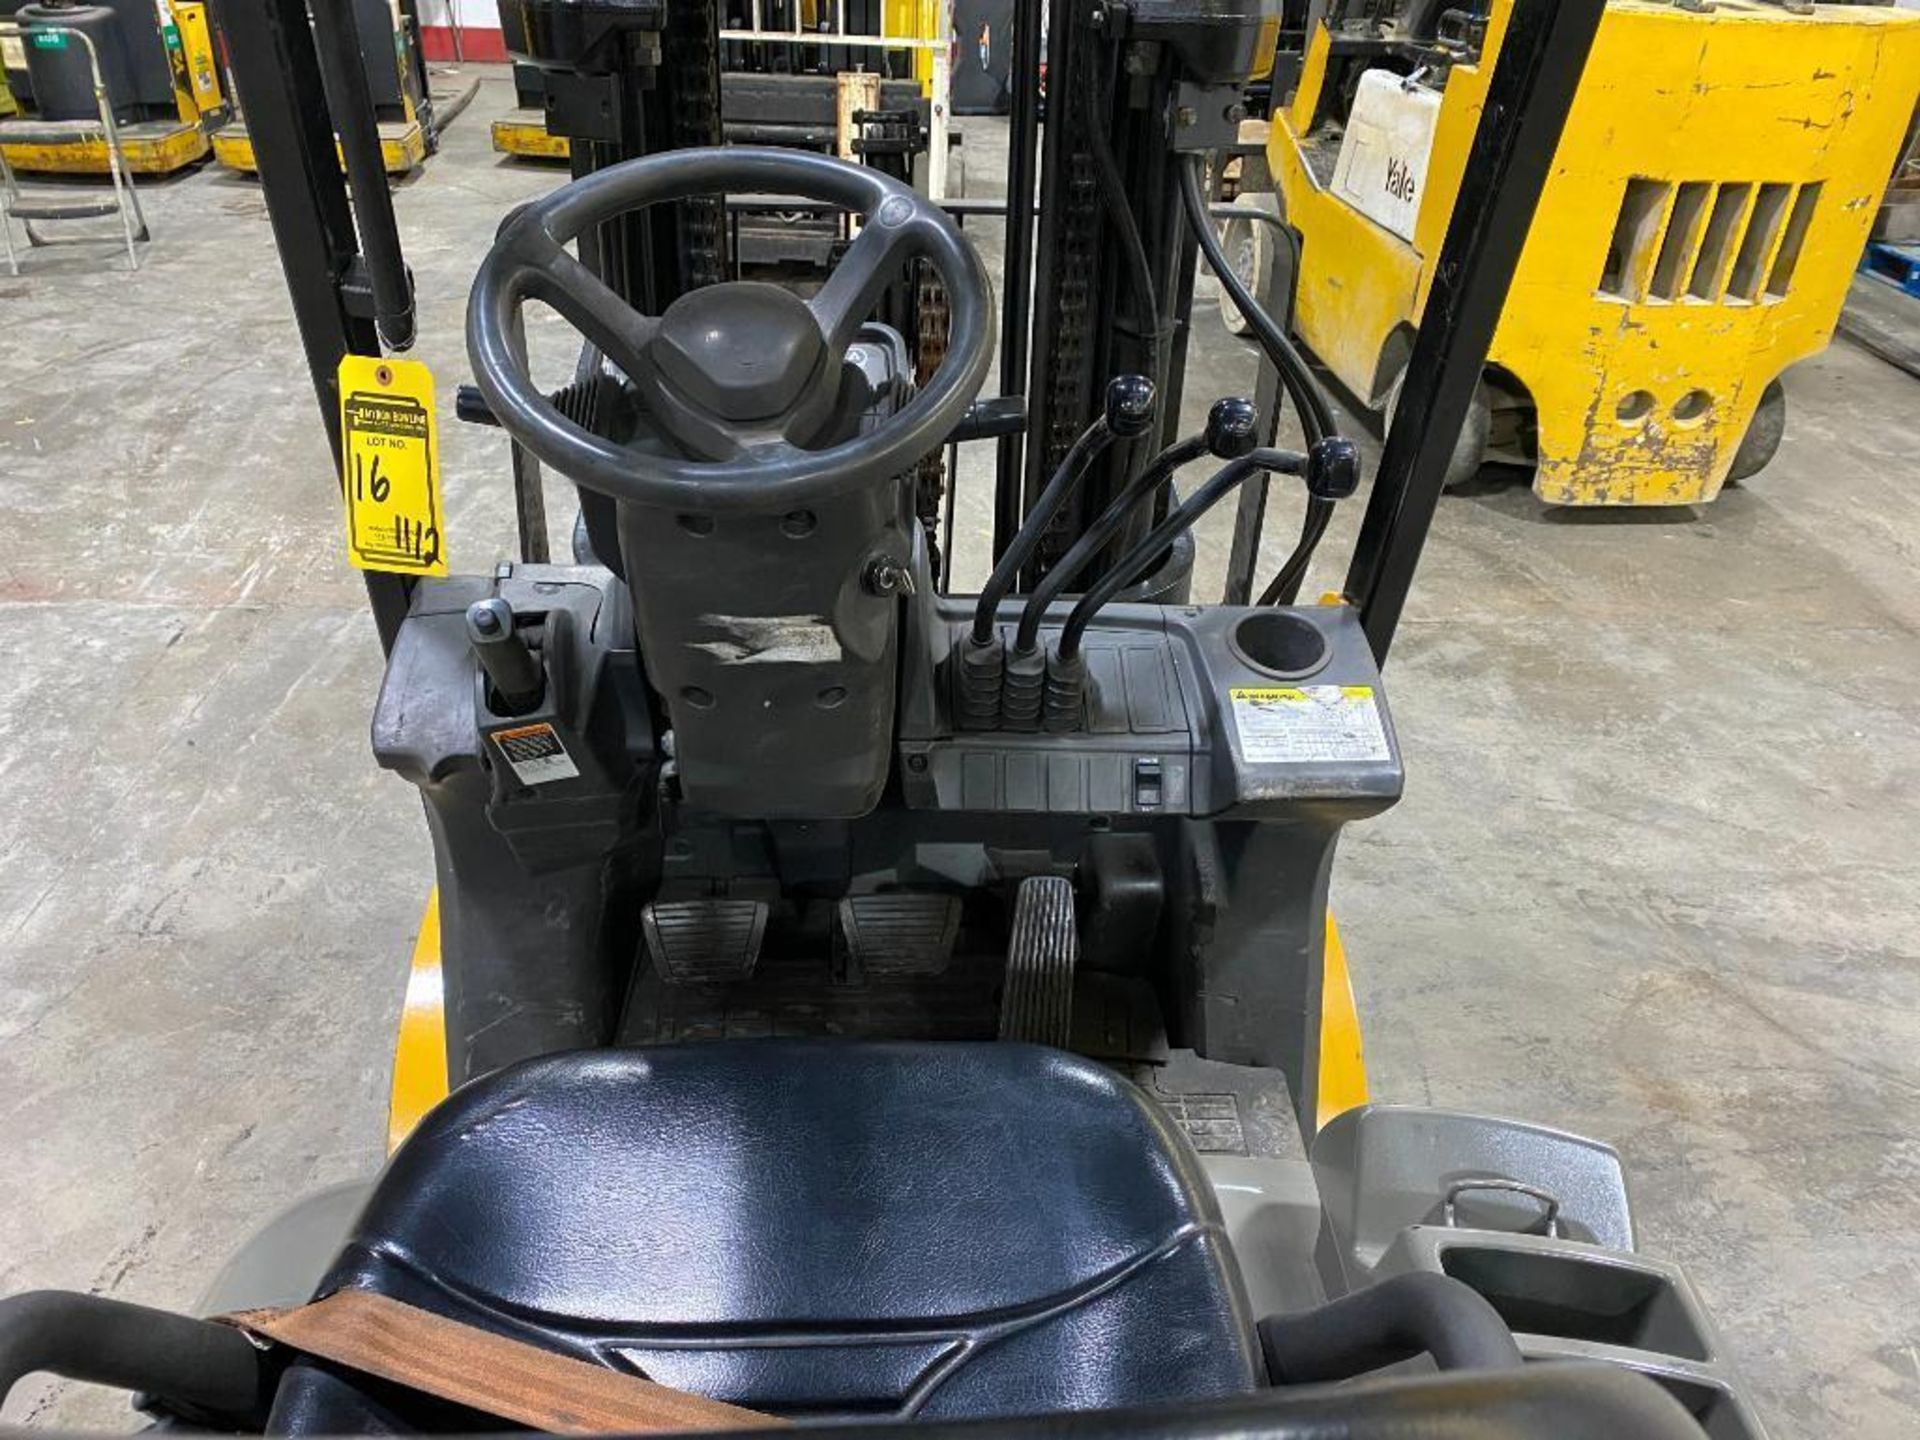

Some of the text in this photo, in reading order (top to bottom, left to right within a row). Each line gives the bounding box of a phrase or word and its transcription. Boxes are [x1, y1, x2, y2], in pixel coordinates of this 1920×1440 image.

[1385, 157, 1415, 203] Yale
[367, 437, 407, 450] LOT NO.
[356, 453, 390, 503] 16
[395, 514, 443, 566] 1112
